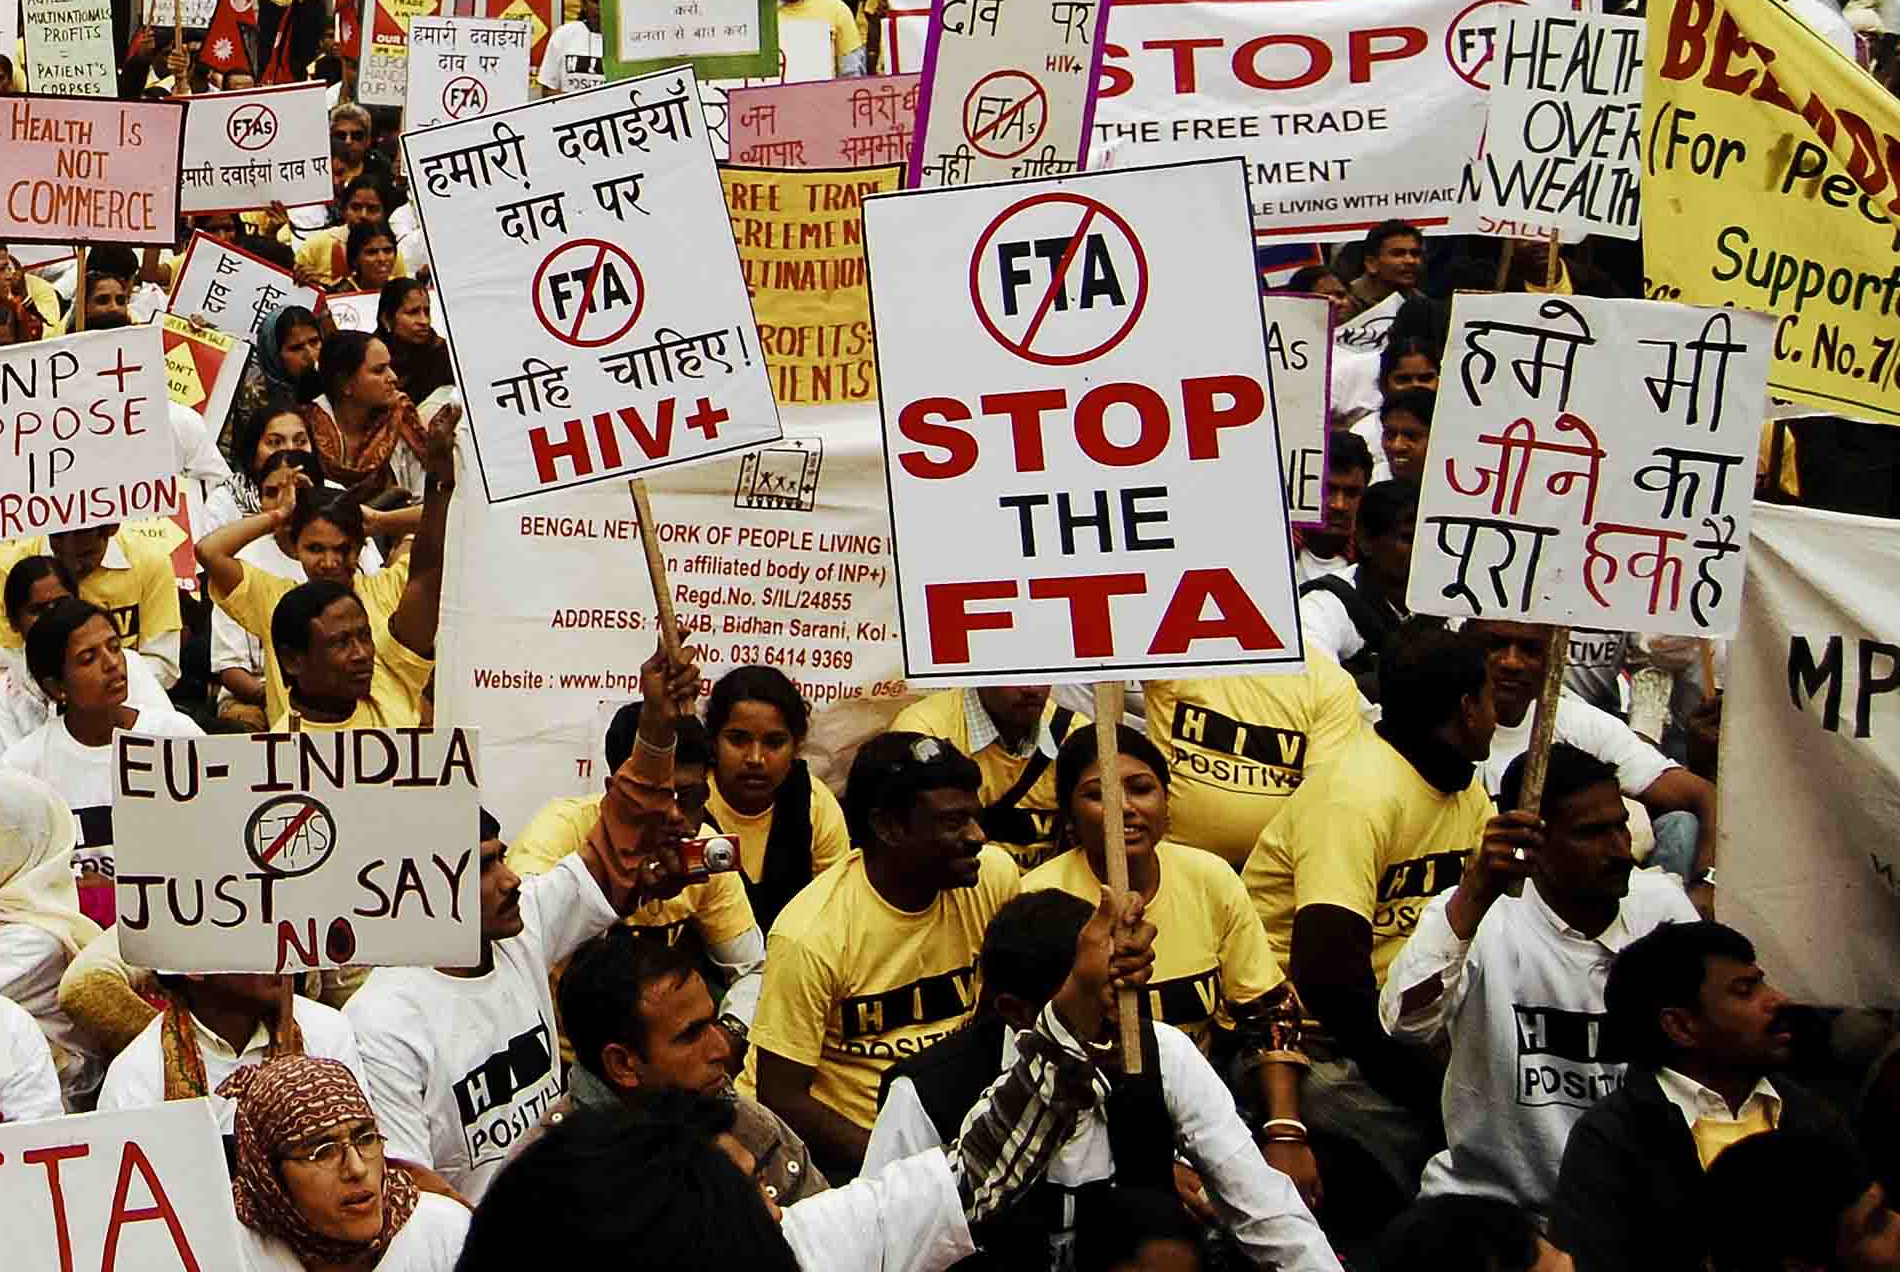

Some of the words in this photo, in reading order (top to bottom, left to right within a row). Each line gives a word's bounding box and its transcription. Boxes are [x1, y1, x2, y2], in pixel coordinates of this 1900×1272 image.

[27, 8, 113, 25] MULTINATIONALS
[44, 26, 101, 41] PROFITS
[1052, 2, 1095, 44] पर
[1046, 55, 1082, 74] HIV+
[1098, 25, 1429, 97] STOP
[11, 103, 93, 145] HEALTH
[233, 117, 273, 137] FTAs
[1094, 120, 1160, 144] THE
[1172, 114, 1259, 141] FREE
[1274, 108, 1389, 135] TRADE
[56, 149, 109, 180] NOT
[312, 156, 329, 178] पर
[420, 122, 530, 198] हमारी
[7, 179, 157, 230] COMMERCE
[594, 172, 650, 221] पर
[1279, 195, 1339, 215] LIVING
[1344, 191, 1390, 210] WITH
[548, 262, 632, 320] FTA
[996, 232, 1127, 317] FTA
[491, 357, 572, 415] नहि
[528, 396, 730, 484] HIV+
[896, 373, 1266, 480] STOP
[28, 447, 76, 494] IP
[1633, 446, 1745, 520] का
[520, 515, 597, 540] BENGAL
[707, 526, 731, 546] OF
[738, 529, 813, 552] PEOPLE
[819, 534, 882, 556] LIVING
[999, 485, 1176, 558] THE
[683, 555, 762, 579] affiliated
[768, 560, 812, 585] body
[816, 563, 834, 582] of
[1583, 521, 1687, 615] हक
[552, 609, 647, 632] ADDRESS:
[724, 615, 785, 637] Bidhan
[790, 618, 852, 641] Sarani,
[857, 621, 887, 642] Kol
[923, 566, 1286, 666] FTA
[474, 669, 546, 690] Website
[731, 644, 762, 665] 033
[765, 646, 807, 667] 6414
[812, 648, 853, 671] 9369
[116, 872, 290, 931] JUST
[354, 849, 472, 924] SAY
[276, 916, 357, 973] NO
